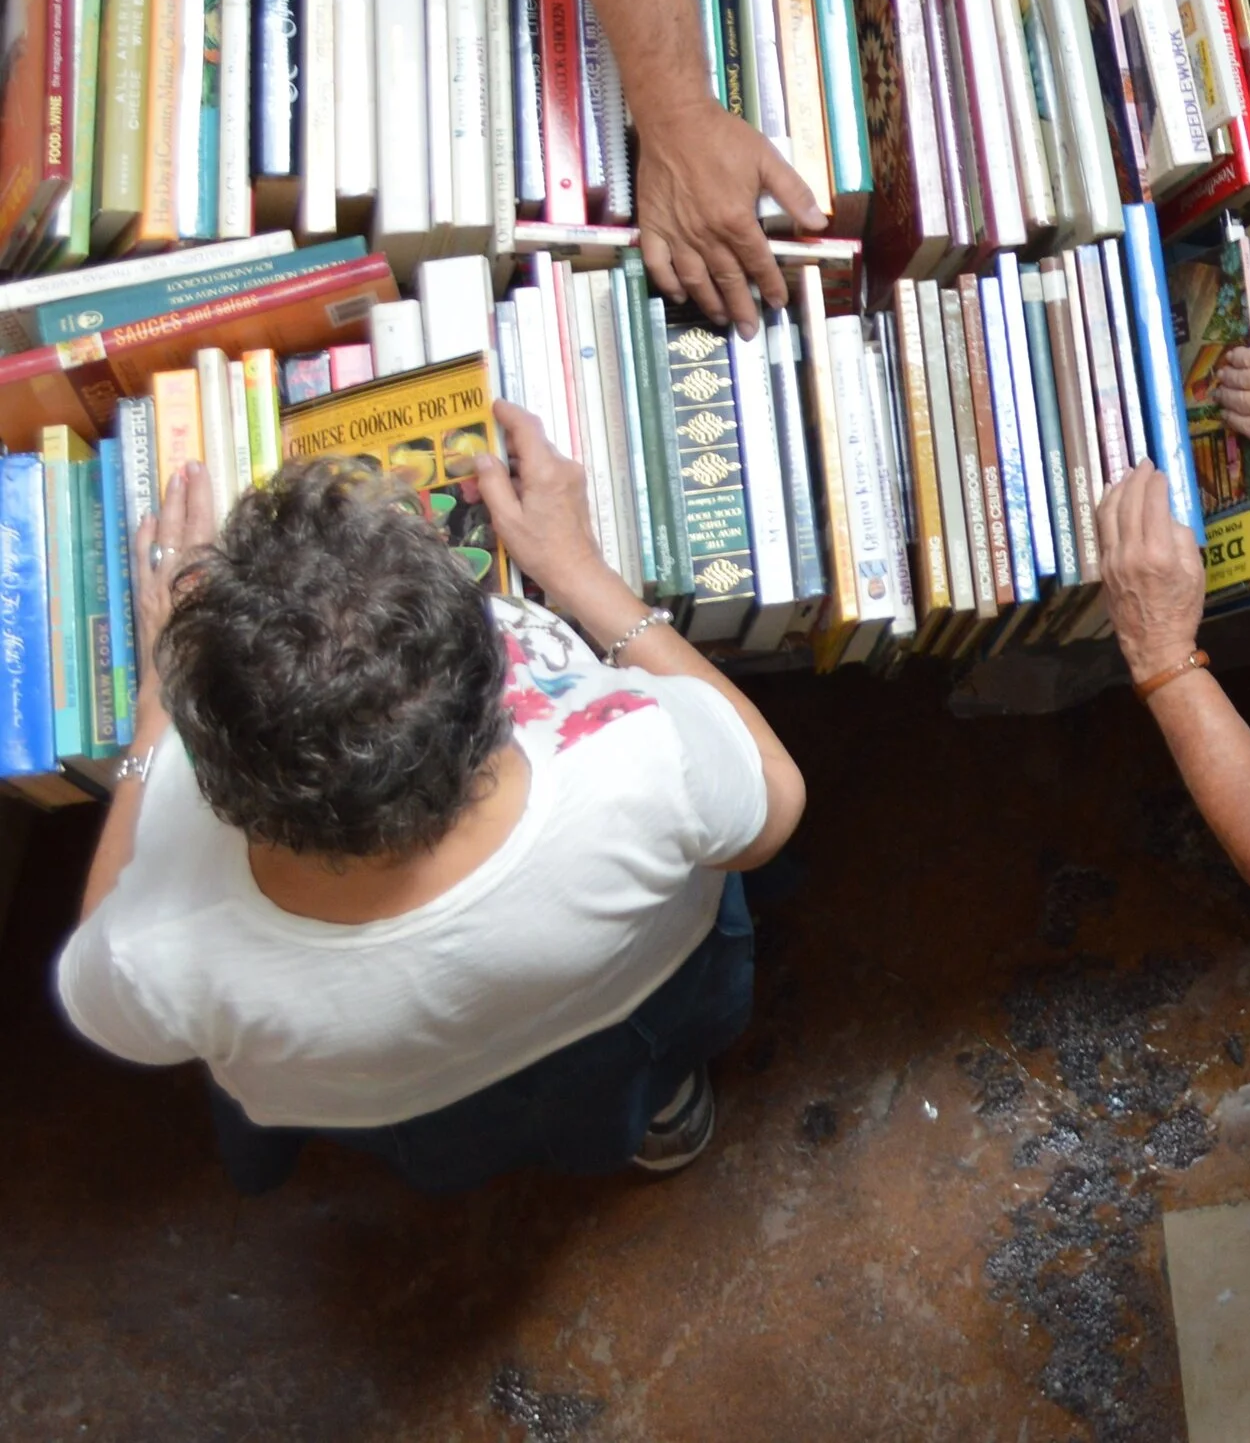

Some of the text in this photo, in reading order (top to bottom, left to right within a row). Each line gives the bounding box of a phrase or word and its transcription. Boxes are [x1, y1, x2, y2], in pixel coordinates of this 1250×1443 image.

[115, 67, 127, 102] ALL
[1162, 28, 1212, 154] NEEDLEWORK
[183, 303, 213, 327] and
[214, 290, 260, 319] salsas
[286, 383, 487, 461] CHINESE COOKING FOR TWO
[972, 523, 986, 547] AND
[981, 465, 1013, 586] WALLS AND CEILINGS
[1047, 449, 1077, 573] DOORS AND WINDOWS
[1078, 503, 1094, 537] LIVING
[928, 535, 948, 592] PLUMBING
[976, 549, 993, 601] KITCHENS
[1083, 538, 1098, 564] NEW
[101, 673, 113, 734] OUTLAW
